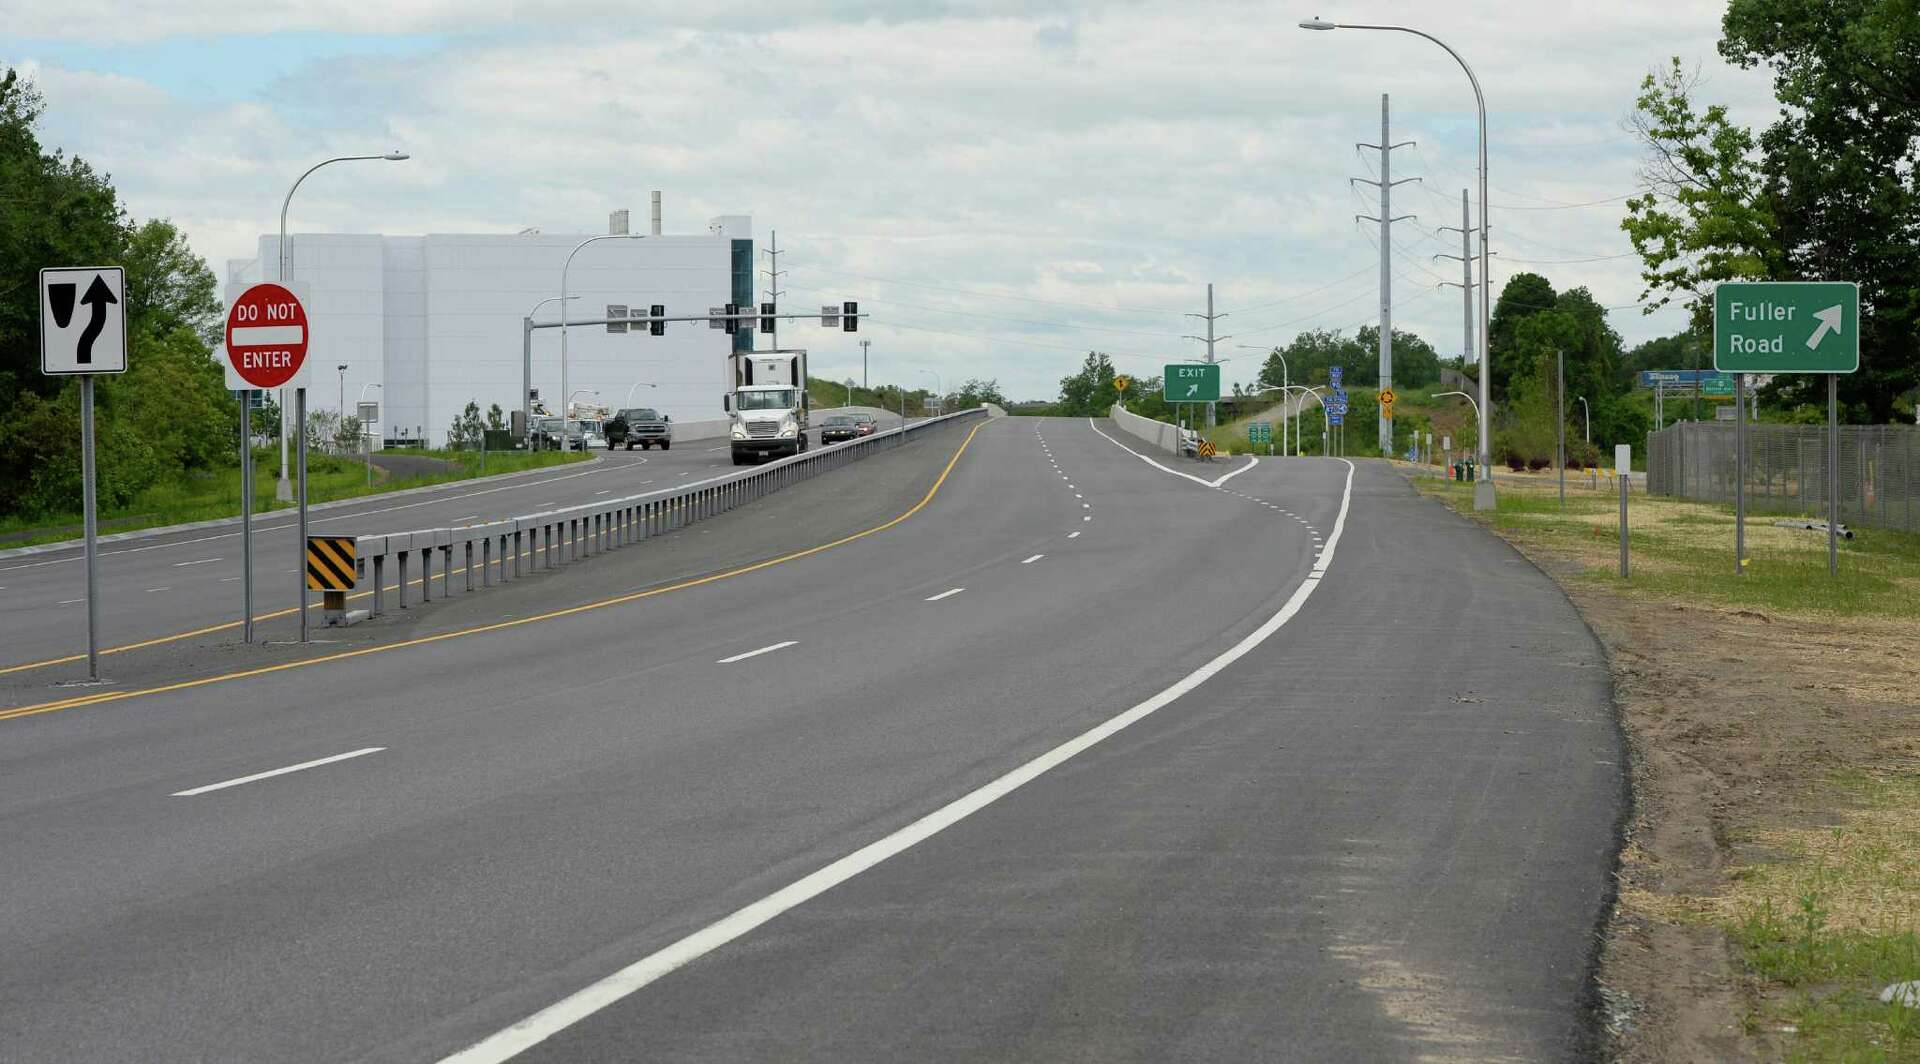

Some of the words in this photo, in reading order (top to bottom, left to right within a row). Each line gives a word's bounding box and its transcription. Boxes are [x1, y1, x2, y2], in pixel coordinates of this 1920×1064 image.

[237, 304, 258, 321] DO
[267, 303, 297, 321] NOT
[1730, 302, 1796, 321] Fuller
[1730, 334, 1783, 353] Road
[243, 351, 292, 369] ENTER
[1178, 368, 1206, 378] EXIT
